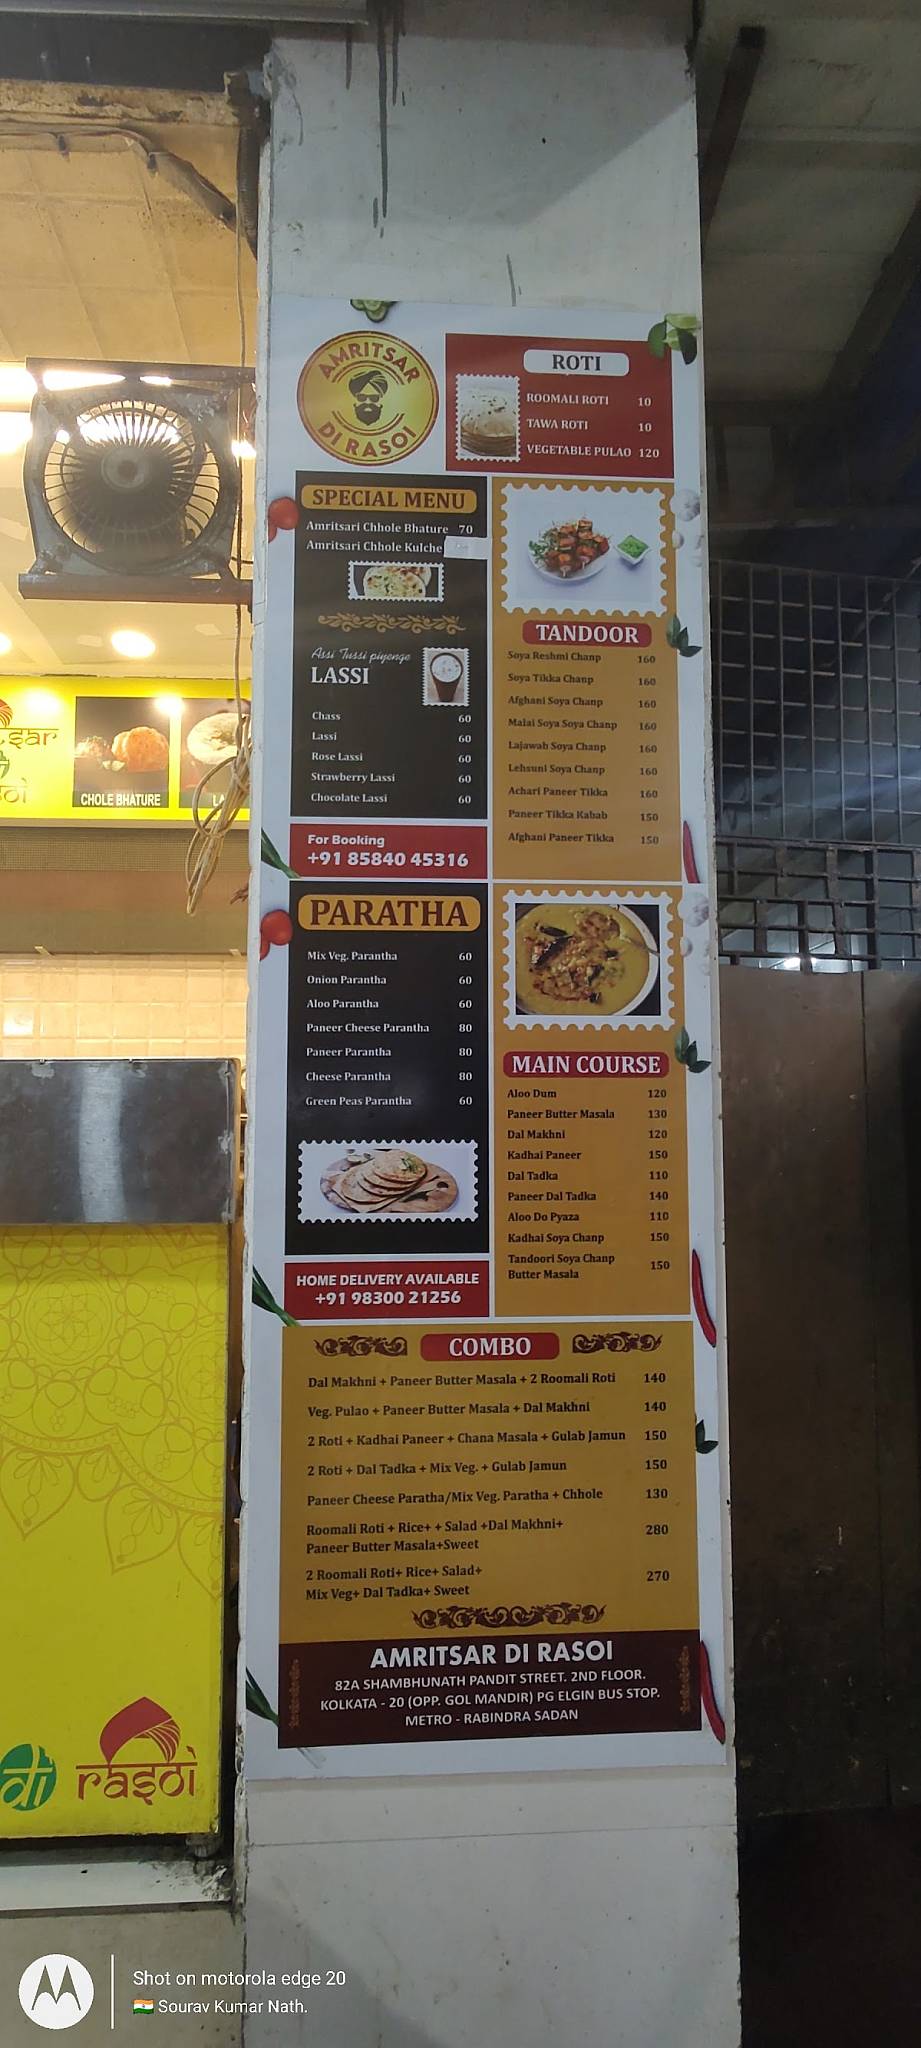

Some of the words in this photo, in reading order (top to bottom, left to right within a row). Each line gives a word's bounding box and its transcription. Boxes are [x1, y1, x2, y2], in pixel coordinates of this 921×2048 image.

[318, 341, 421, 384] AMRITSAR
[552, 354, 601, 371] ROTI
[527, 393, 579, 404] ROOMALI
[582, 395, 608, 405] ROTI
[638, 397, 651, 406] 10
[526, 418, 558, 429] TAWA
[561, 420, 588, 430] ROTI
[639, 423, 652, 432] 10
[317, 421, 343, 444] DI
[346, 425, 416, 457] RASOI
[527, 444, 591, 456] VEGETABLE
[594, 447, 631, 457] PULAO
[640, 448, 659, 458] 120
[313, 489, 399, 507] SPECIAL
[405, 491, 465, 509] MENU
[306, 521, 360, 531] Amritsari
[363, 522, 401, 532] Chhole
[404, 523, 448, 534] Bhature
[459, 525, 473, 534] 70
[306, 540, 360, 551] Amritsari
[363, 541, 402, 552] Chhole
[404, 542, 443, 553] Kulche
[536, 624, 639, 643] TANDOOR
[311, 647, 334, 659] Assi
[311, 667, 369, 684] LASSI
[508, 696, 546, 706] Afghani
[548, 696, 570, 707] Soya
[572, 697, 603, 708] Chanp
[639, 700, 656, 708] 160
[312, 711, 341, 720] Chass
[458, 715, 471, 723] 60
[312, 731, 337, 740] Lassi
[458, 735, 471, 743] 60
[311, 772, 368, 784] Strawberry
[370, 773, 395, 782] Lassi
[458, 775, 471, 783] 60
[311, 793, 360, 802] Chocolate
[362, 794, 387, 803] Lassi
[458, 795, 471, 804] 60
[508, 786, 540, 796] Achari
[543, 787, 577, 796] Paneer
[579, 787, 608, 797] Tikka
[640, 790, 658, 798] 160
[81, 793, 114, 807] CHOLE
[116, 793, 161, 807] BHATURE
[508, 809, 544, 819] Paneer
[545, 810, 574, 819] Tikka
[640, 813, 659, 822] 150
[308, 834, 329, 844] For
[332, 835, 385, 848] Booking
[308, 851, 340, 865] +91
[347, 852, 406, 866] 85840
[410, 853, 468, 867] 45316
[310, 899, 469, 927] PARATHA
[308, 951, 326, 960] Mix
[328, 951, 349, 962] Veg.
[352, 951, 397, 960] Parantha
[459, 952, 472, 960] 60
[307, 1023, 343, 1032] Paneer
[345, 1023, 381, 1032] Cheese
[383, 1023, 429, 1032] Parantha
[459, 1024, 472, 1032] 80
[513, 1056, 570, 1073] MAIN
[576, 1056, 660, 1073] COURSE
[507, 1089, 530, 1098] Aloo
[533, 1089, 557, 1098] Dum
[648, 1089, 667, 1098] 120
[306, 1097, 336, 1105] Green
[339, 1097, 363, 1105] Peas
[365, 1096, 411, 1105] Parantha
[459, 1096, 472, 1105] 60
[507, 1109, 544, 1119] Paneer
[545, 1109, 578, 1119] Butter
[580, 1109, 615, 1119] Masala
[648, 1109, 667, 1119] 130
[508, 1150, 543, 1160] Kadhai
[546, 1150, 582, 1159] Paneer
[649, 1150, 668, 1159] 150
[508, 1212, 531, 1222] Aloo
[534, 1212, 548, 1221] Do
[550, 1212, 580, 1224] Pyaza
[650, 1211, 669, 1221] 110
[508, 1254, 555, 1263] Tandoori
[557, 1254, 581, 1266] Soya
[582, 1253, 615, 1265] Chanp
[651, 1260, 670, 1270] 150
[297, 1275, 337, 1286] HOME
[340, 1274, 403, 1285] DELIVERY
[405, 1273, 479, 1285] AVAILABLE
[508, 1270, 541, 1279] Butter
[544, 1269, 579, 1279] Masala
[315, 1292, 345, 1305] +91
[351, 1291, 404, 1304] 98300
[408, 1291, 461, 1304] 21256
[449, 1337, 531, 1356] COMBO
[307, 1495, 350, 1506] Paneer
[353, 1494, 395, 1505] Cheese
[398, 1492, 473, 1505] Paratha/Mix
[476, 1491, 500, 1504] Veg.
[503, 1489, 549, 1501] Paratha
[552, 1491, 559, 1499] +
[563, 1488, 603, 1499] Chhole
[646, 1488, 668, 1499] 130
[306, 1570, 313, 1581] 2
[317, 1568, 367, 1581] Roomali
[647, 1570, 670, 1582] 270
[306, 1589, 328, 1600] Mix
[363, 1586, 383, 1598] Dal
[434, 1585, 470, 1596] Sweet
[370, 1644, 496, 1668] AMRITSAR
[505, 1643, 528, 1663] DI
[538, 1640, 612, 1662] RASOI
[335, 1680, 360, 1691] 82A
[363, 1676, 465, 1690] SHAMBHUNATH
[470, 1674, 517, 1686] PANDIT
[571, 1671, 597, 1682] 2ND
[601, 1669, 646, 1680] FLOOR.
[321, 1698, 377, 1710] KOLKATA
[389, 1697, 404, 1708] 20
[408, 1696, 441, 1709] (OPP.
[445, 1695, 471, 1705] GOL
[475, 1691, 533, 1704] MANDIR)
[537, 1691, 554, 1702] PG
[558, 1690, 594, 1701] ELGIN
[598, 1688, 623, 1700] BUS
[626, 1688, 660, 1699] STOP.
[406, 1714, 452, 1726] METRO
[464, 1711, 531, 1724] RABINDRA
[534, 1709, 578, 1721] SADAN
